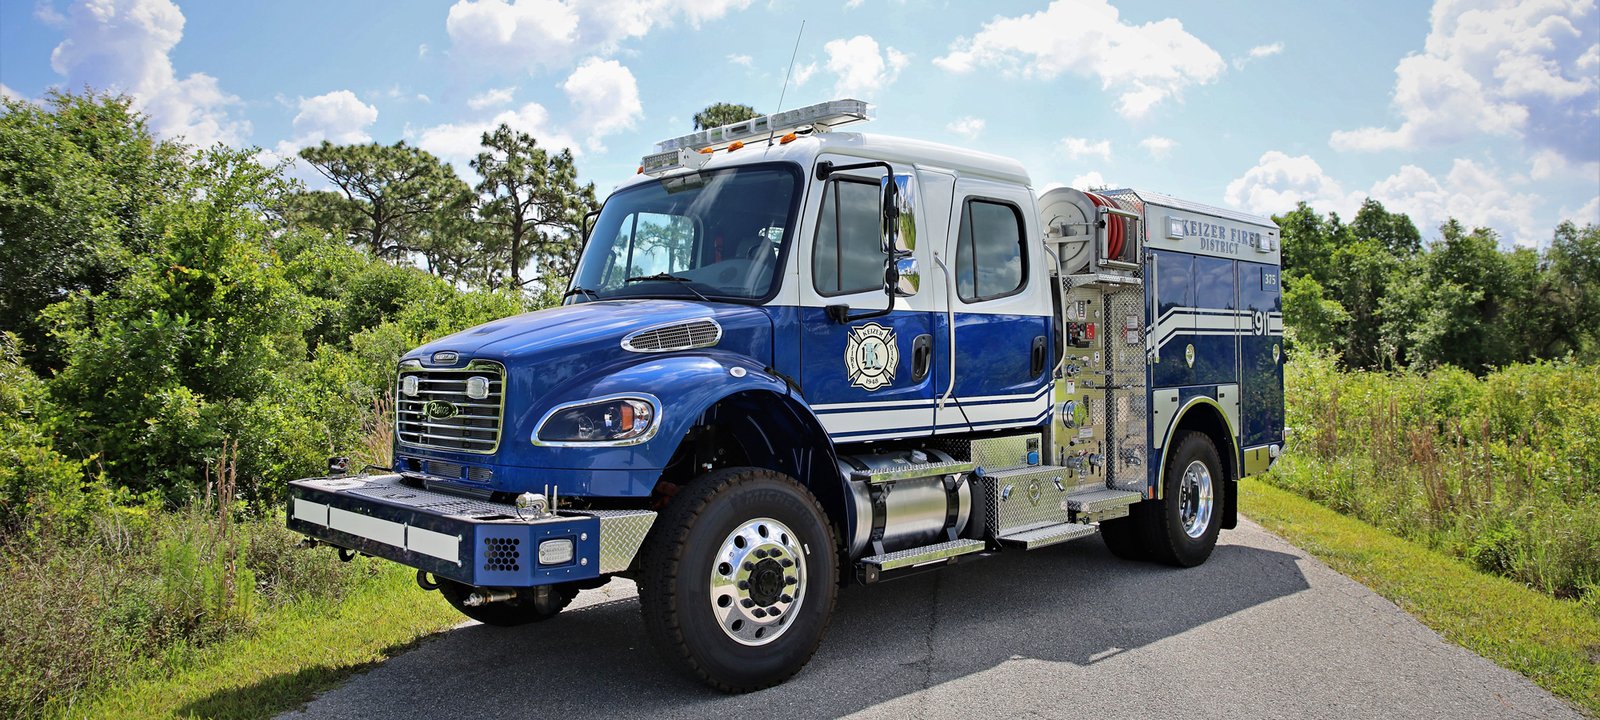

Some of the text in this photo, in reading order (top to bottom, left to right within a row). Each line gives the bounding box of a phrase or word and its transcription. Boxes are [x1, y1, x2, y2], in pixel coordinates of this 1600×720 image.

[1182, 220, 1255, 248] KEIZER FIRE
[1200, 237, 1239, 255] DISTRICT
[1264, 273, 1276, 285] 375
[862, 328, 883, 337] KEIZER
[862, 343, 883, 370] K
[430, 402, 450, 416] Pierce
